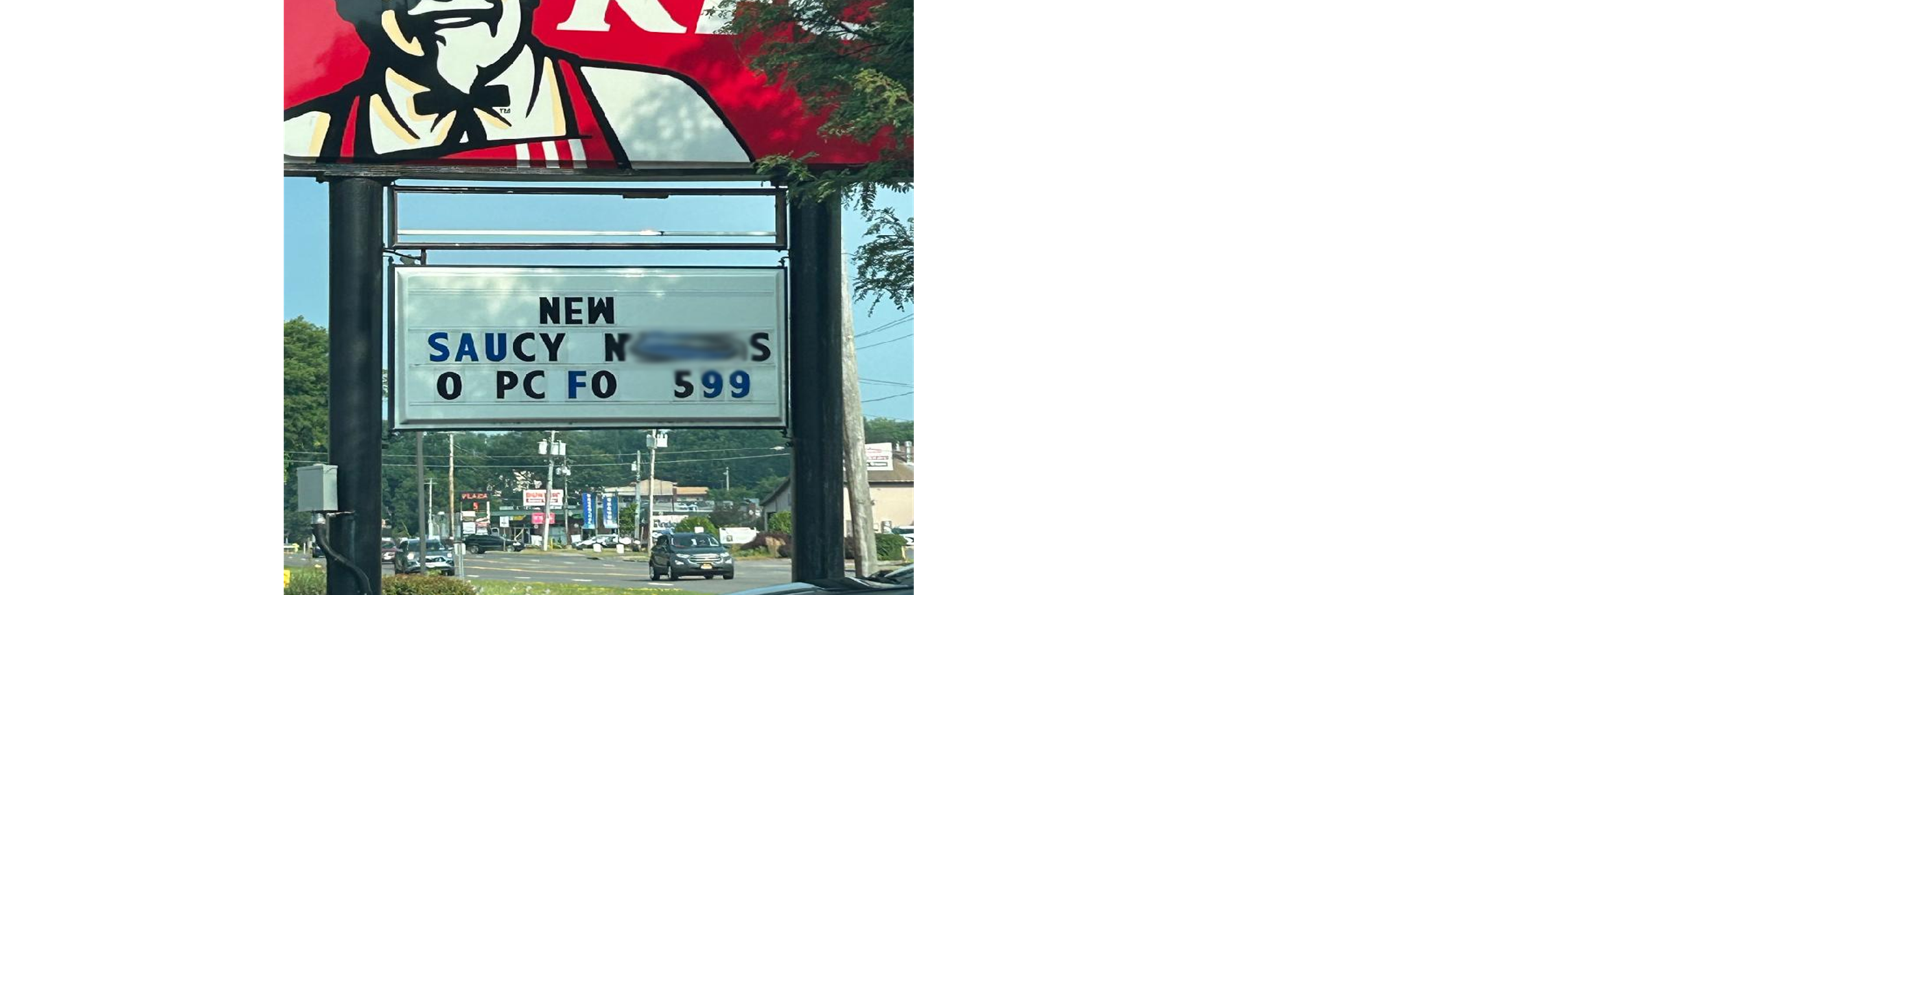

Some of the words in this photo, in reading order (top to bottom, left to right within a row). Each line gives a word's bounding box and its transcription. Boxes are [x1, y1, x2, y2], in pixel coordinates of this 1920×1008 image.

[539, 296, 615, 325] NEW
[427, 332, 566, 363] SAUCY
[496, 369, 546, 400] PC
[673, 369, 751, 399] 599
